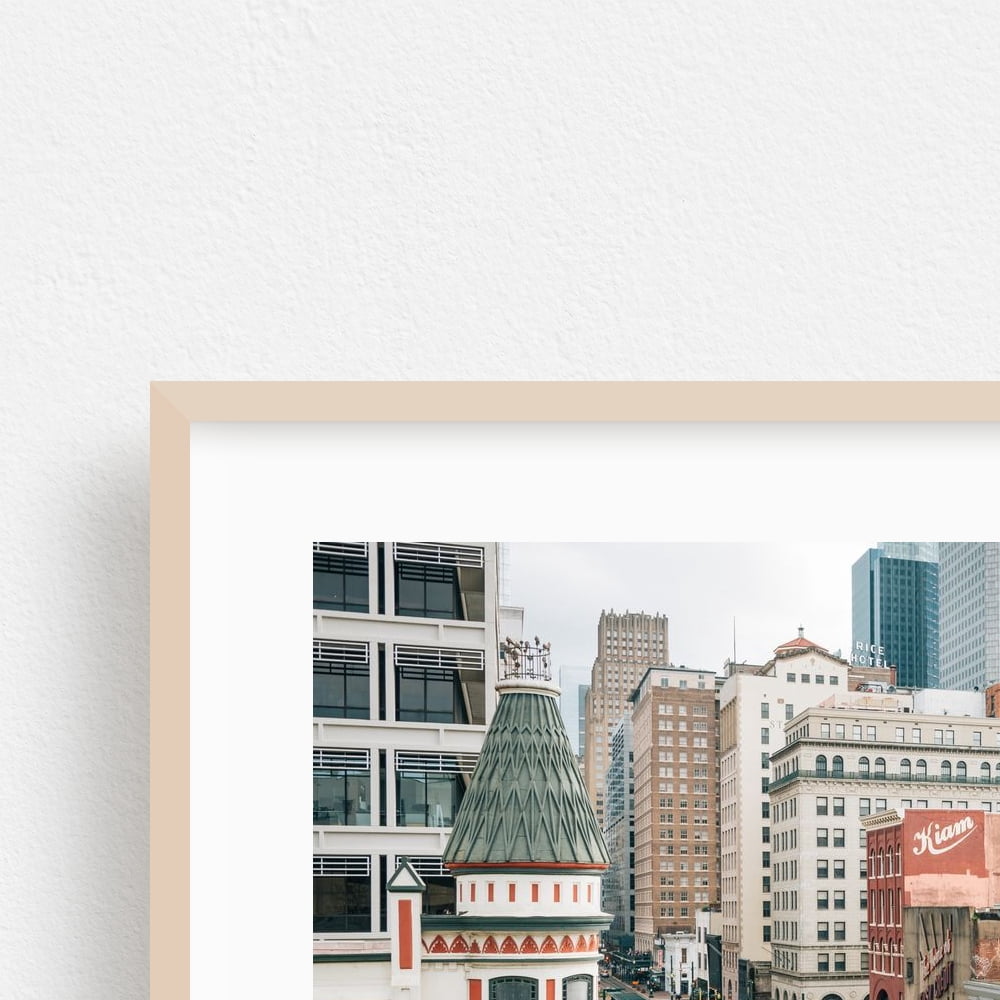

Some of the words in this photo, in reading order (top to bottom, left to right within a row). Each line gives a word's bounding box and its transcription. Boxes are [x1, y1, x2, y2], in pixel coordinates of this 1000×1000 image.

[856, 640, 885, 655] RICE
[851, 653, 890, 669] HOTEL
[912, 816, 977, 855] Kiam
